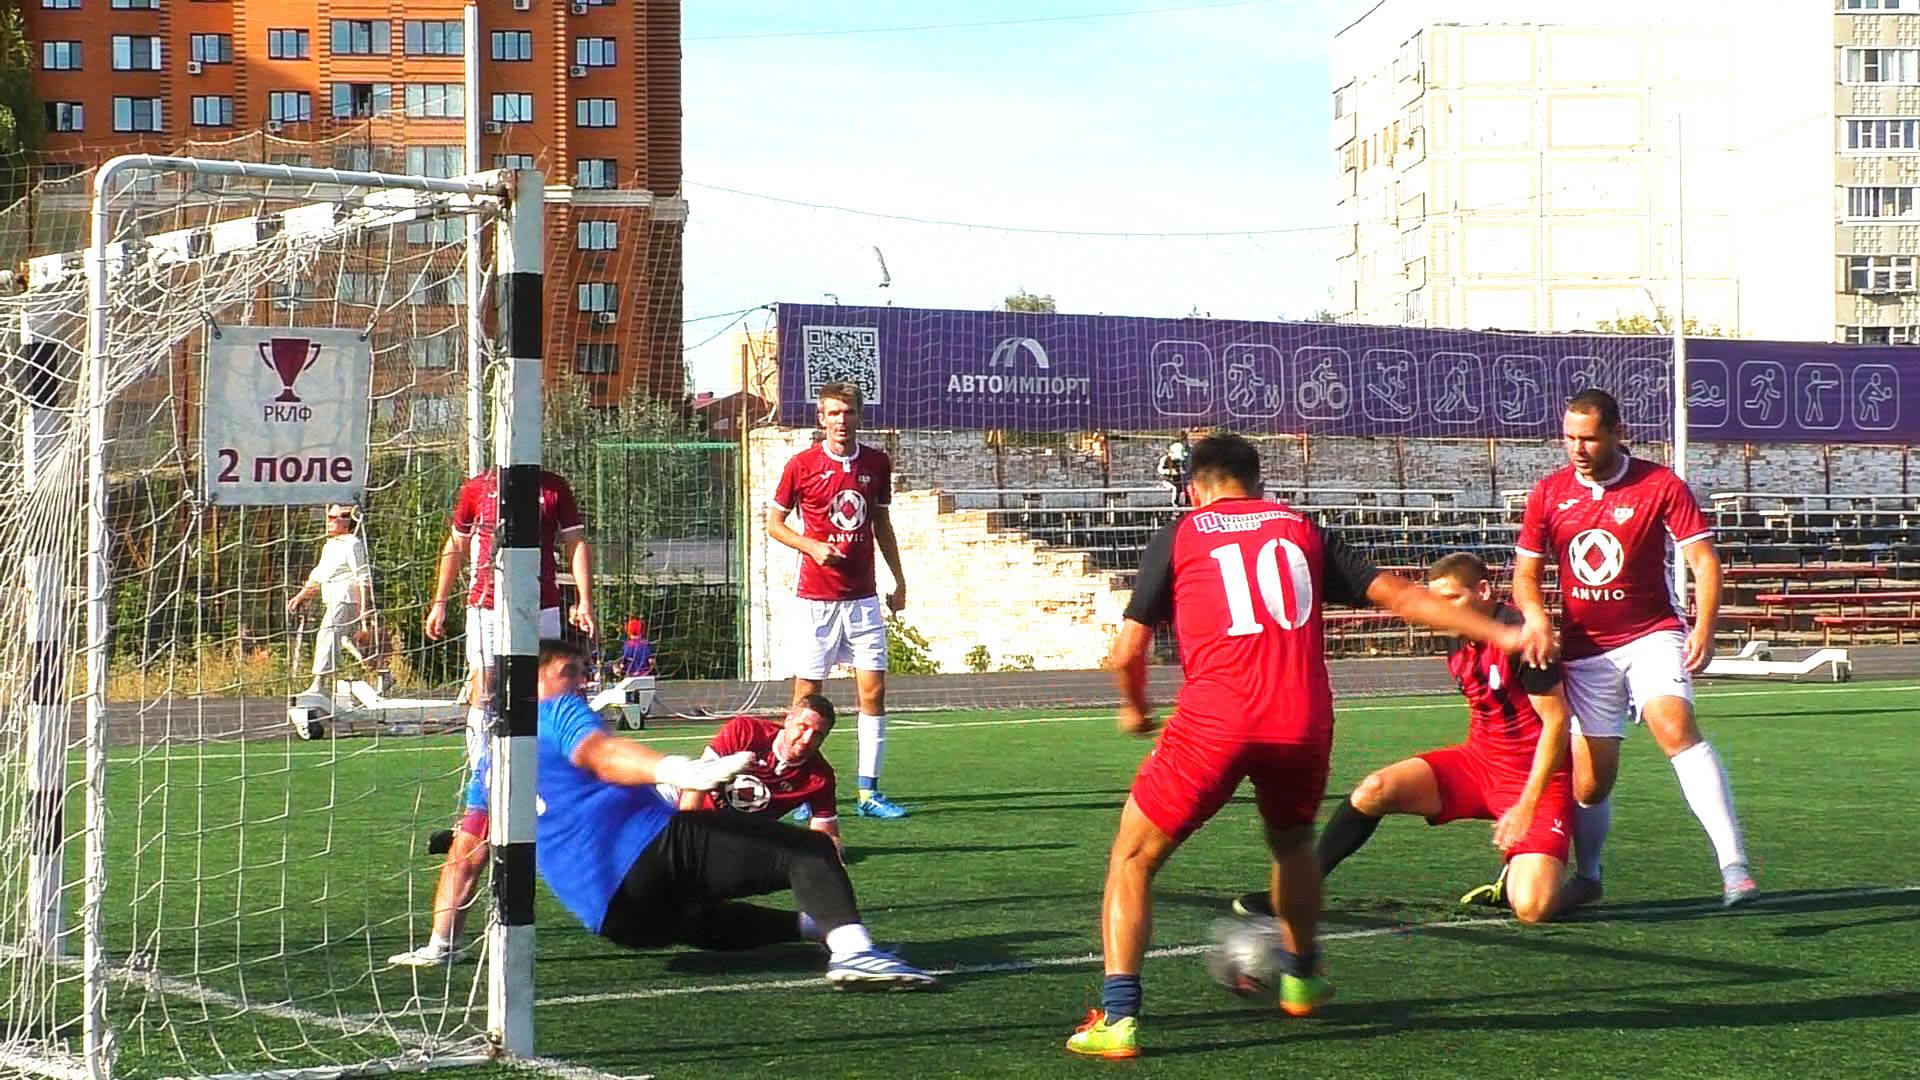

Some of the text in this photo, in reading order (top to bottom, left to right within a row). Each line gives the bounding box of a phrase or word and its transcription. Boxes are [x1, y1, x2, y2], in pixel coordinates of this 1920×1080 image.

[947, 374, 1090, 396] АВТОИМПОРТ
[263, 405, 312, 422] РКЛФ
[217, 449, 353, 483] 2 поле
[827, 533, 866, 543] ANVIO
[1209, 537, 1313, 637] 10
[1571, 587, 1626, 601] ANVIO
